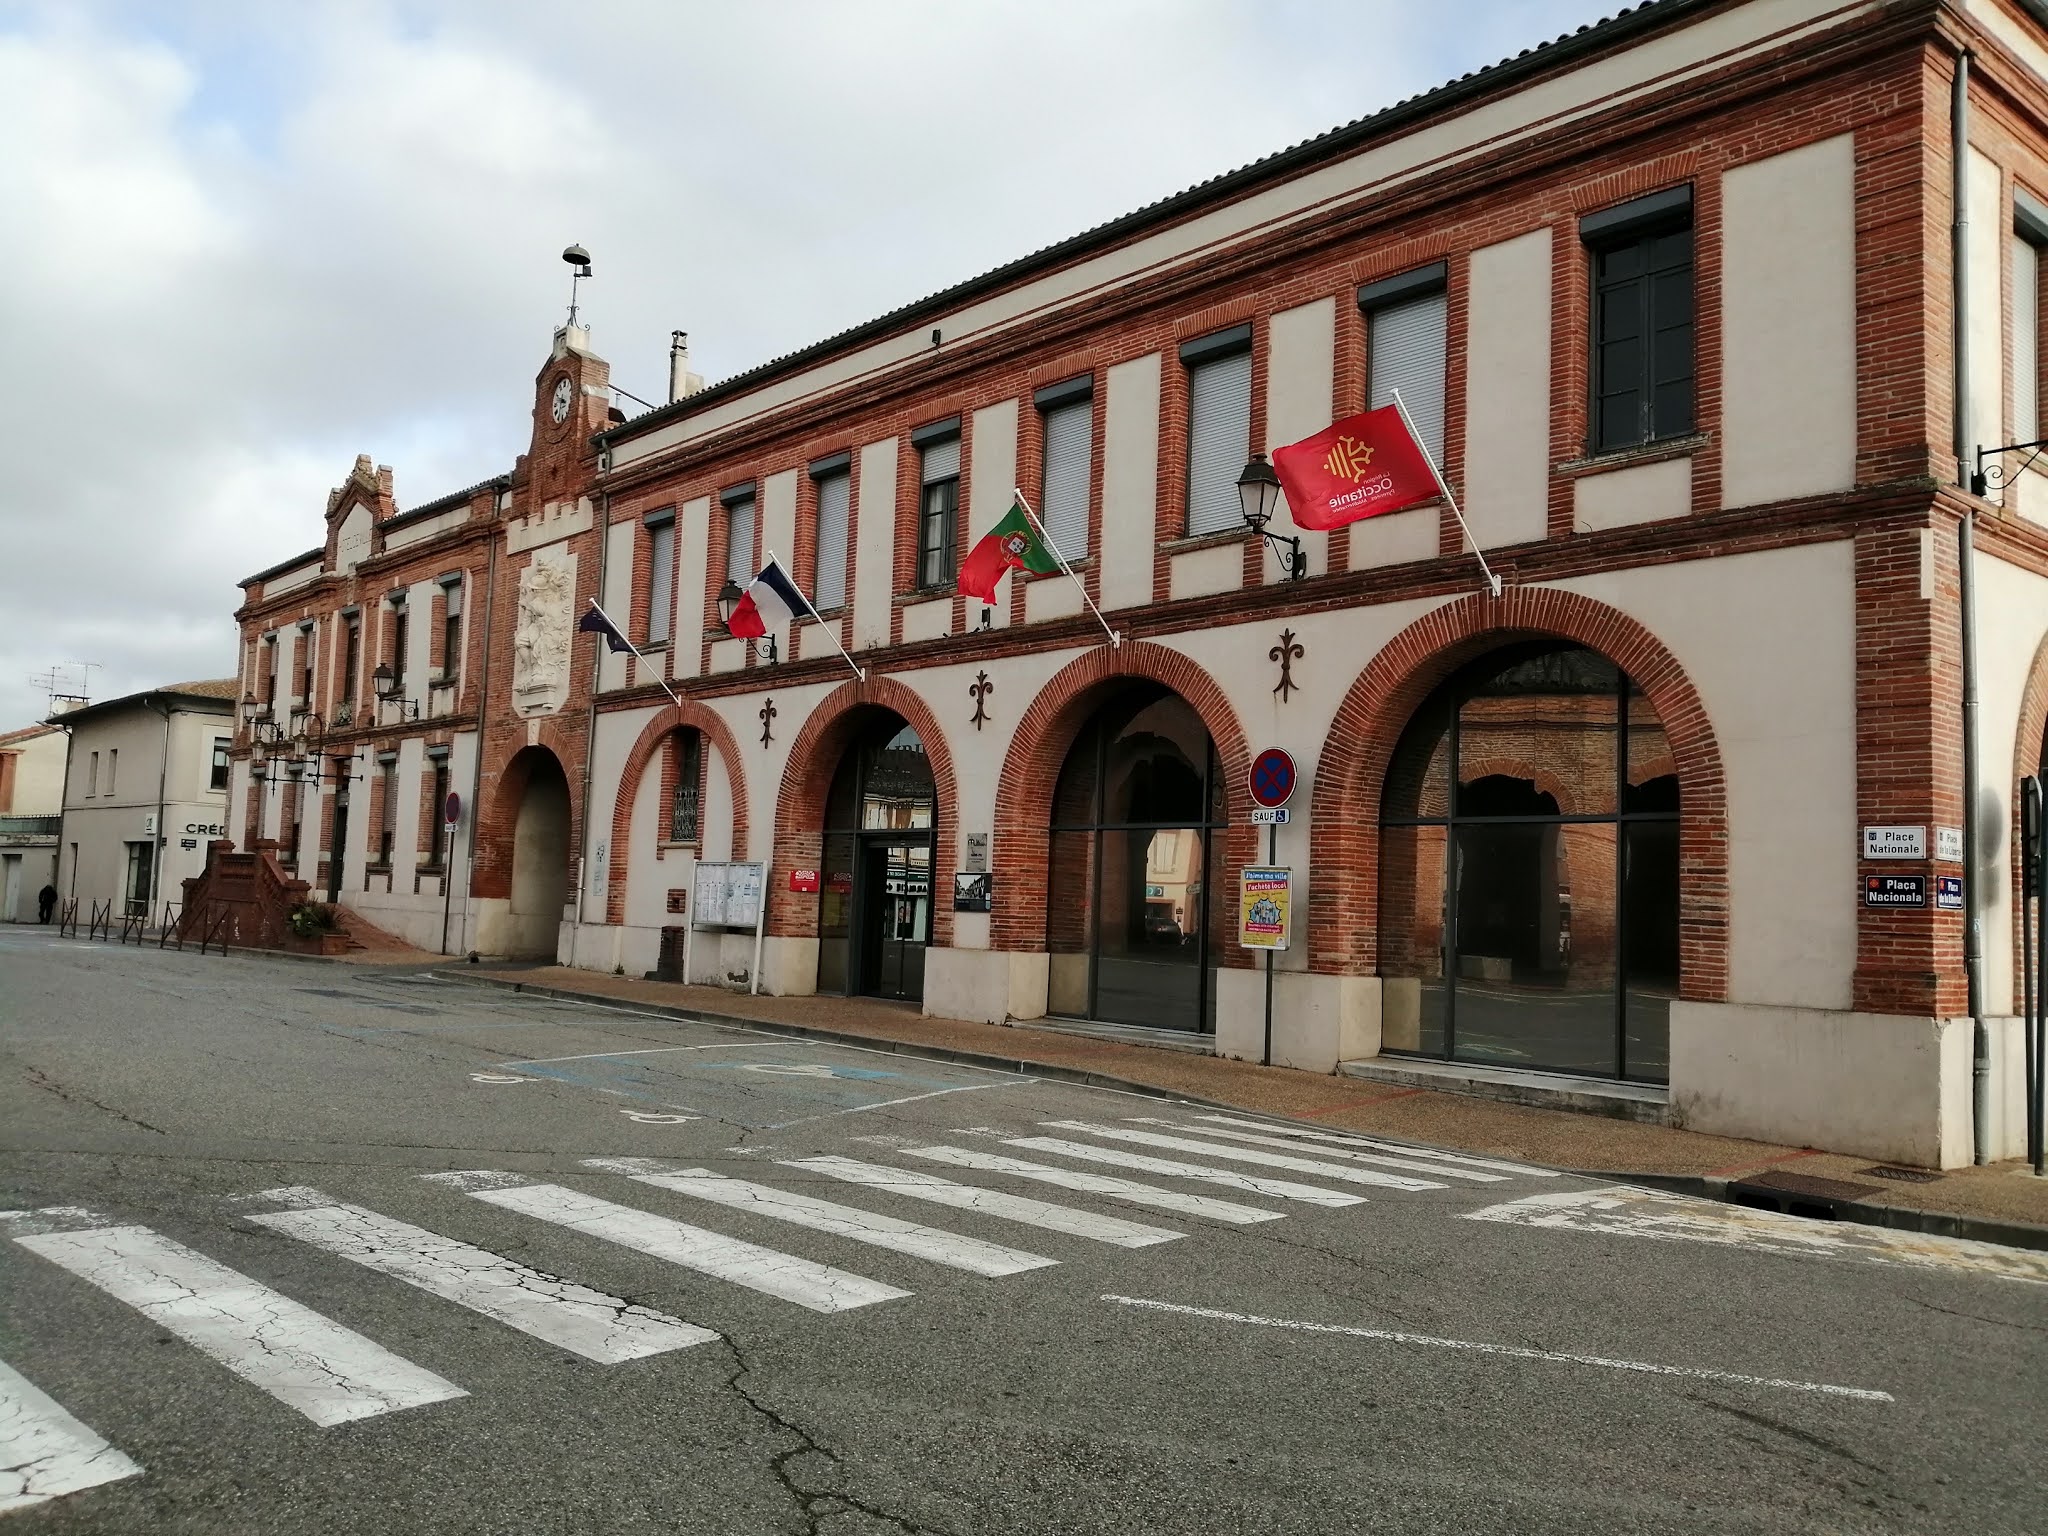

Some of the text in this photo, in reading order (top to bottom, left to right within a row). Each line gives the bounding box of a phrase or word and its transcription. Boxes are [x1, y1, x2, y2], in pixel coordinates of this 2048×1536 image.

[1254, 812, 1274, 821] SAUF
[1885, 832, 1914, 841] Place
[1870, 843, 1920, 853] Nationale
[1275, 872, 1287, 880] ville
[1271, 881, 1287, 889] local
[1886, 879, 1916, 891] Plaça
[1869, 891, 1922, 902] Nacionala
